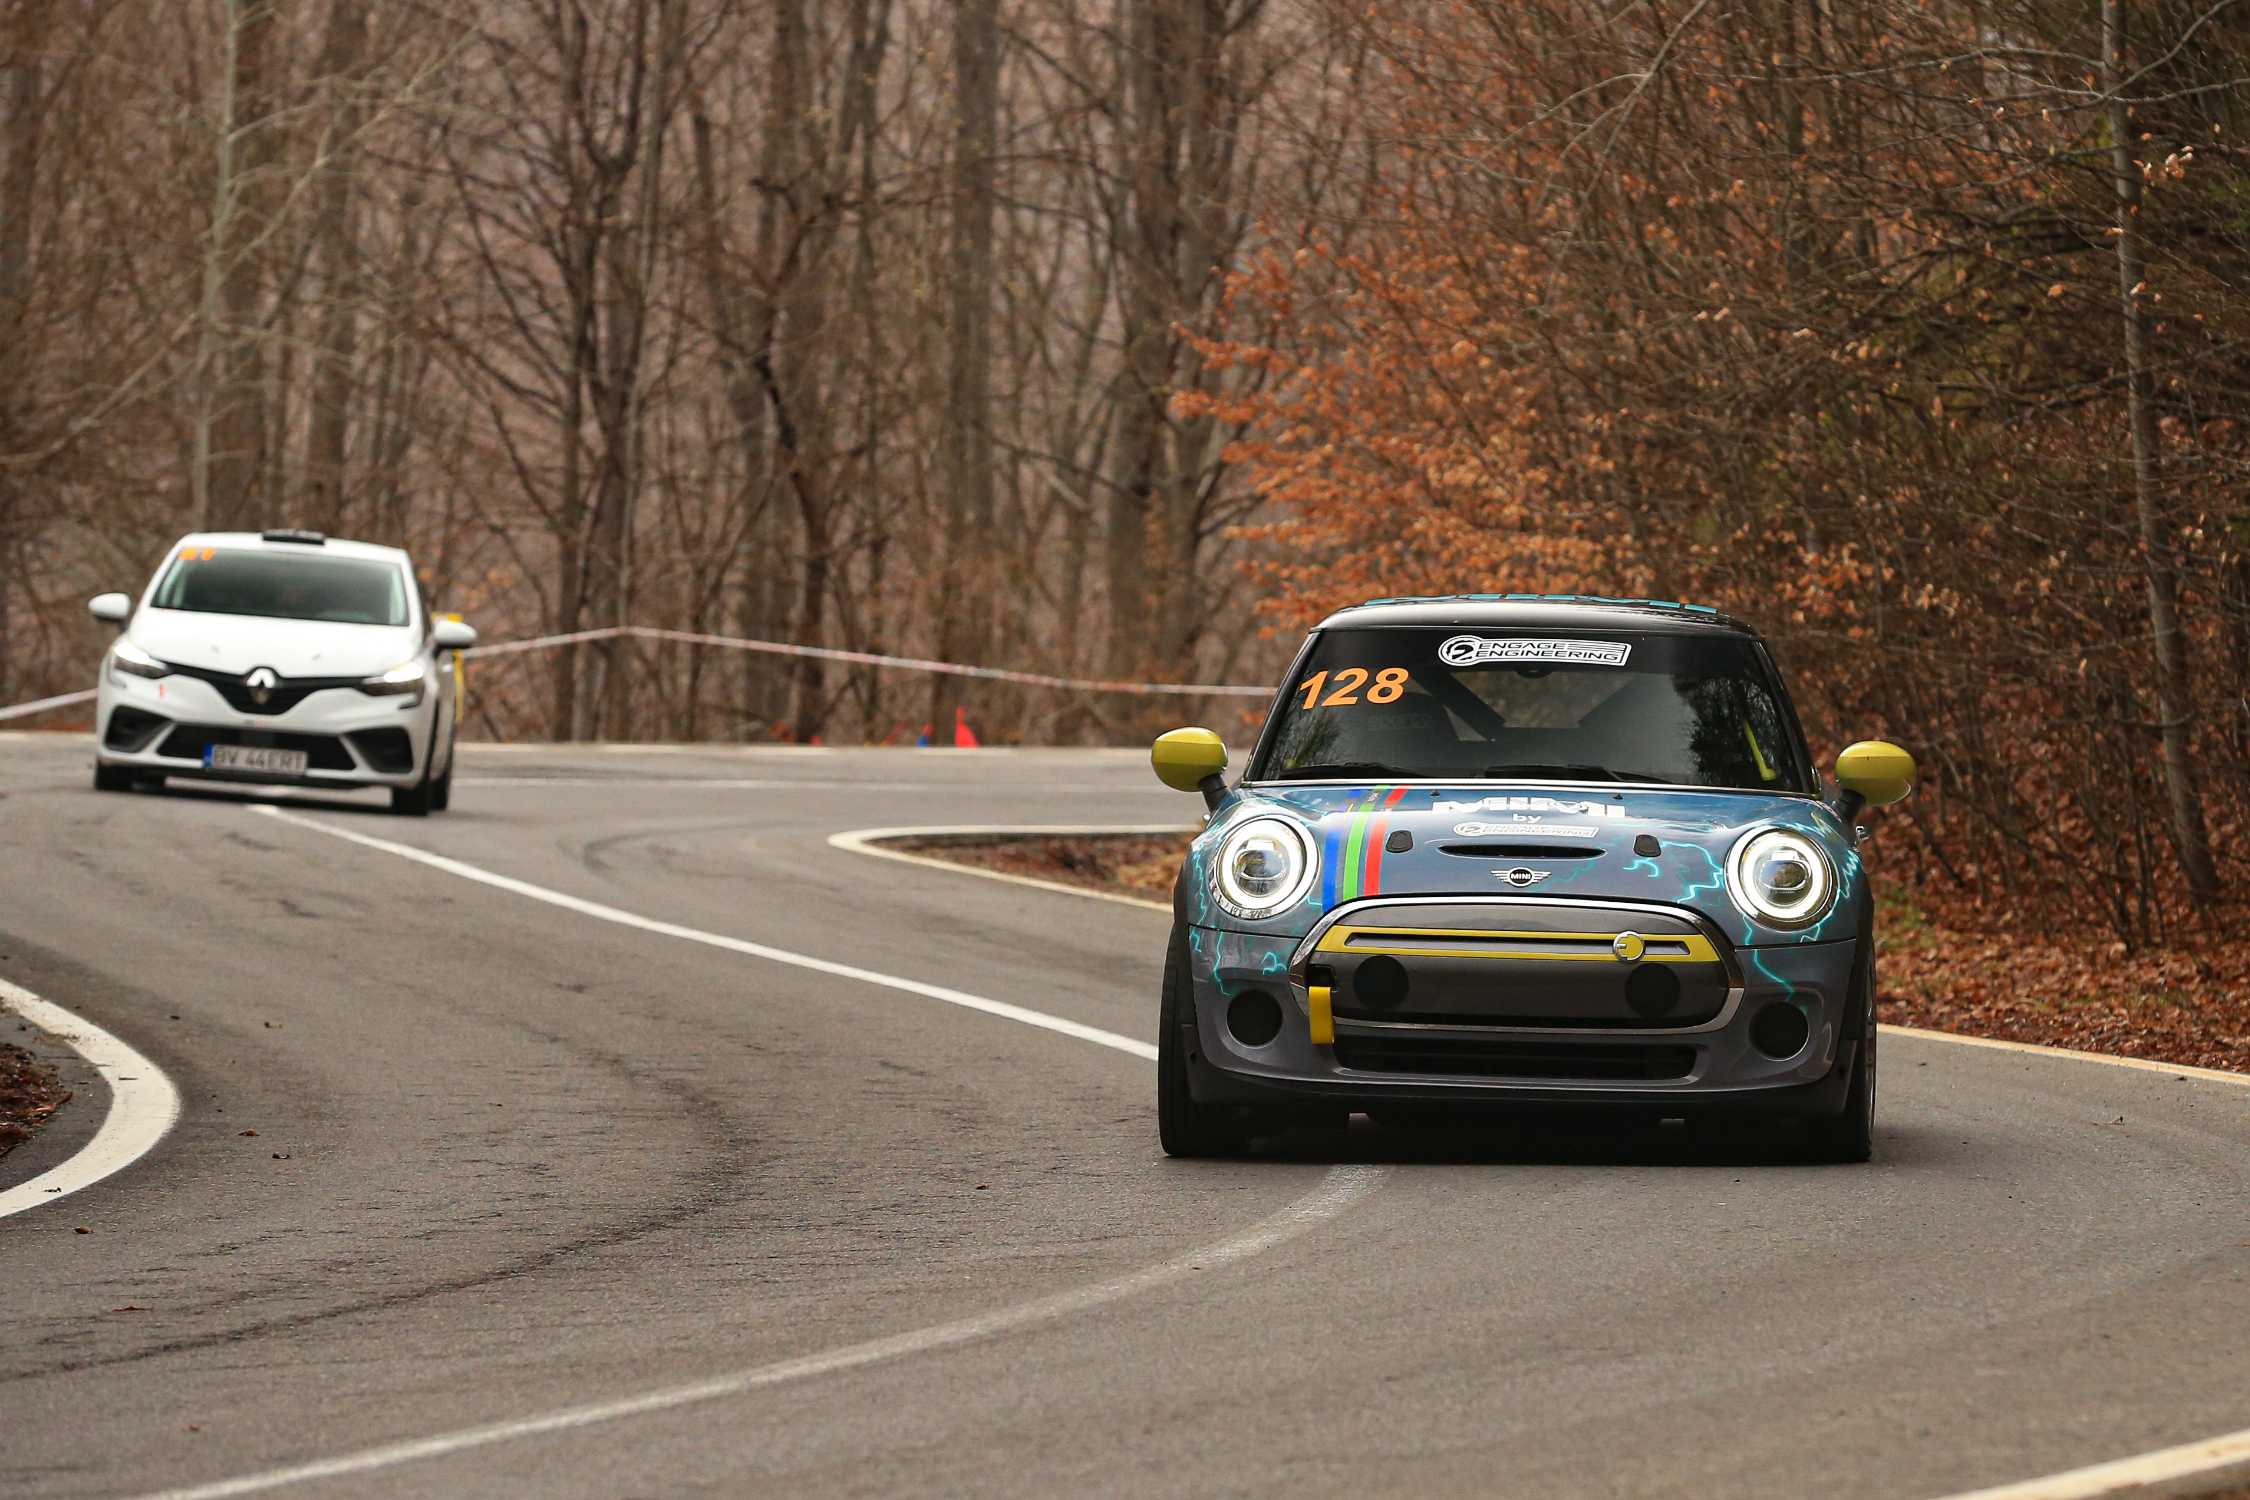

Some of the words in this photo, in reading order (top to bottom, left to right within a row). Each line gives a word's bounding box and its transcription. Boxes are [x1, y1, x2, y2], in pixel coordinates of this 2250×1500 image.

[1478, 642, 1566, 650] ENGAGE
[1475, 650, 1619, 661] ENGINEERING
[1299, 667, 1409, 710] 128
[1512, 813, 1542, 824] by
